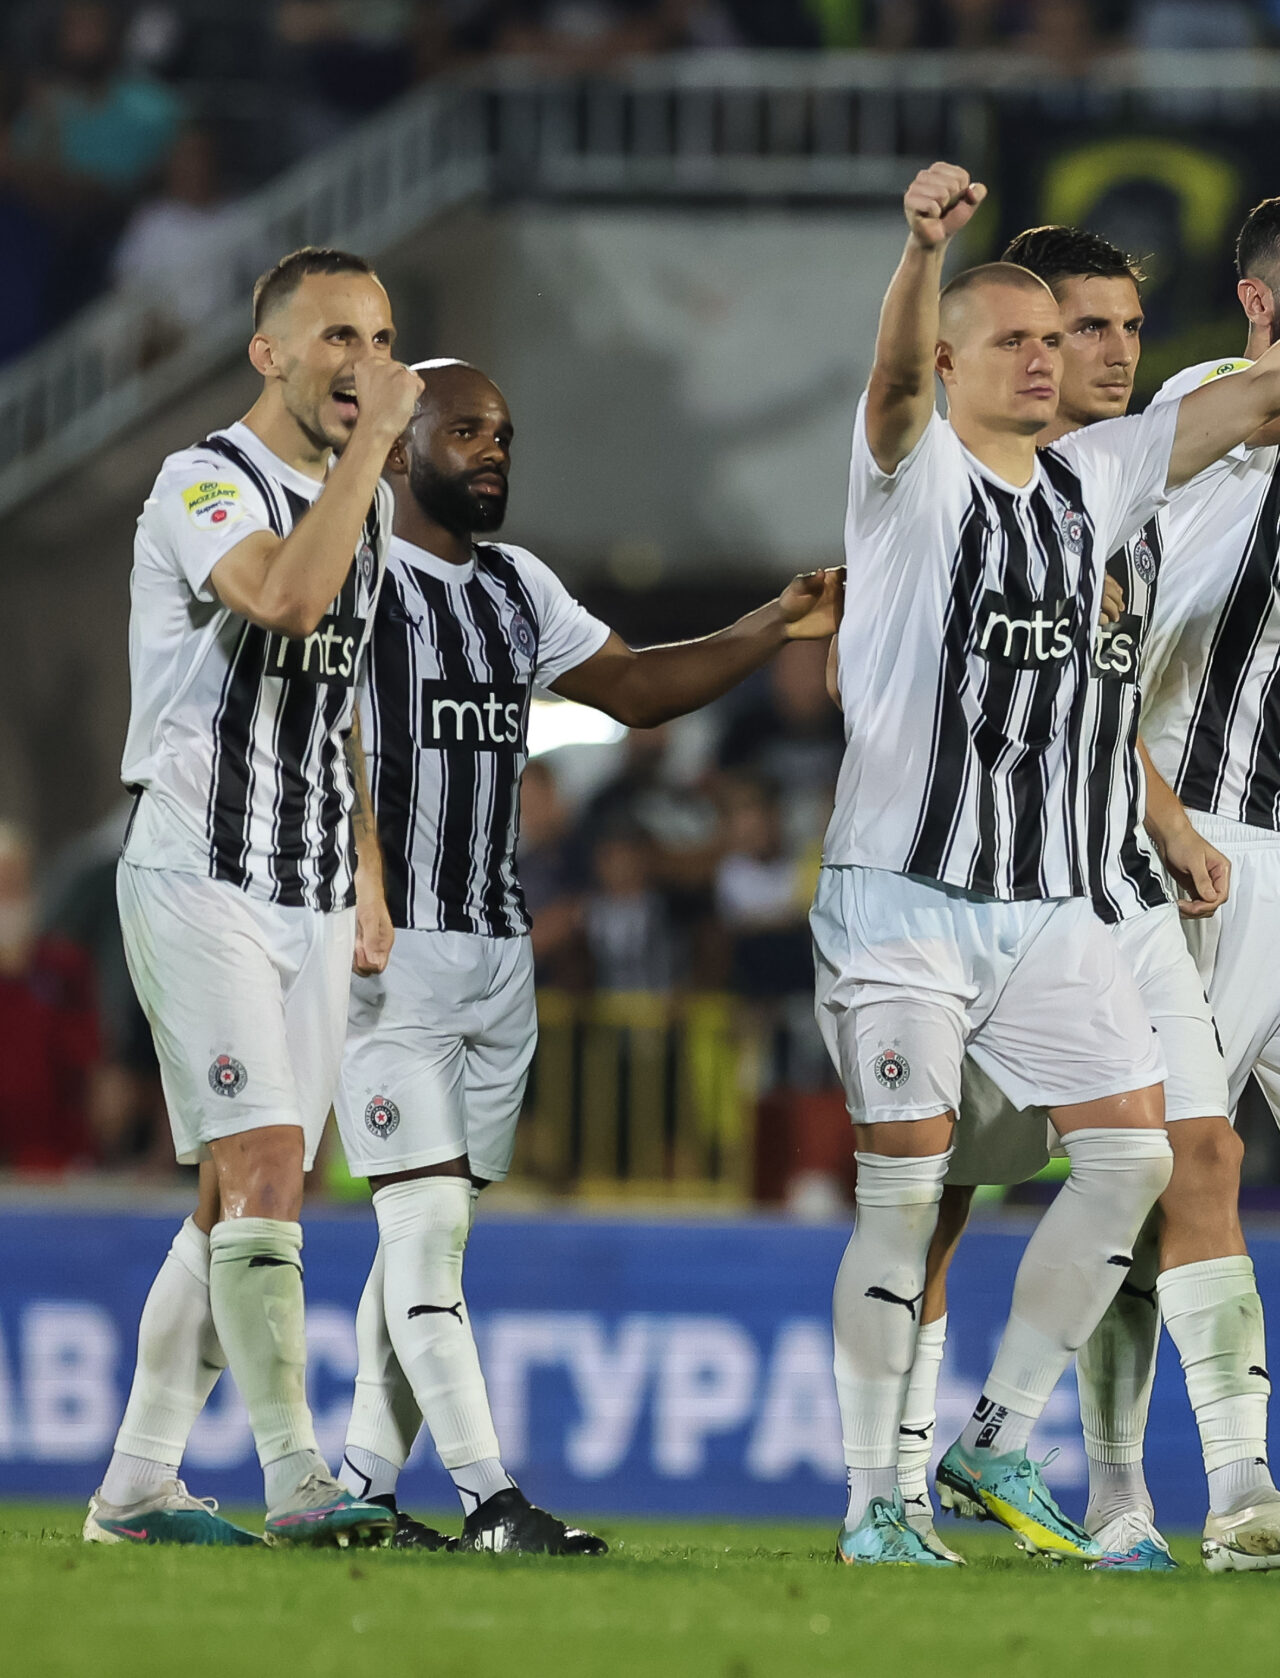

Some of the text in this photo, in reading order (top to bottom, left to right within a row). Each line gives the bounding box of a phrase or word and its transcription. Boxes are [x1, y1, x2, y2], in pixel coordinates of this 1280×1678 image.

[980, 610, 1073, 661] mts
[1094, 625, 1134, 673] ts
[432, 692, 520, 743] mts
